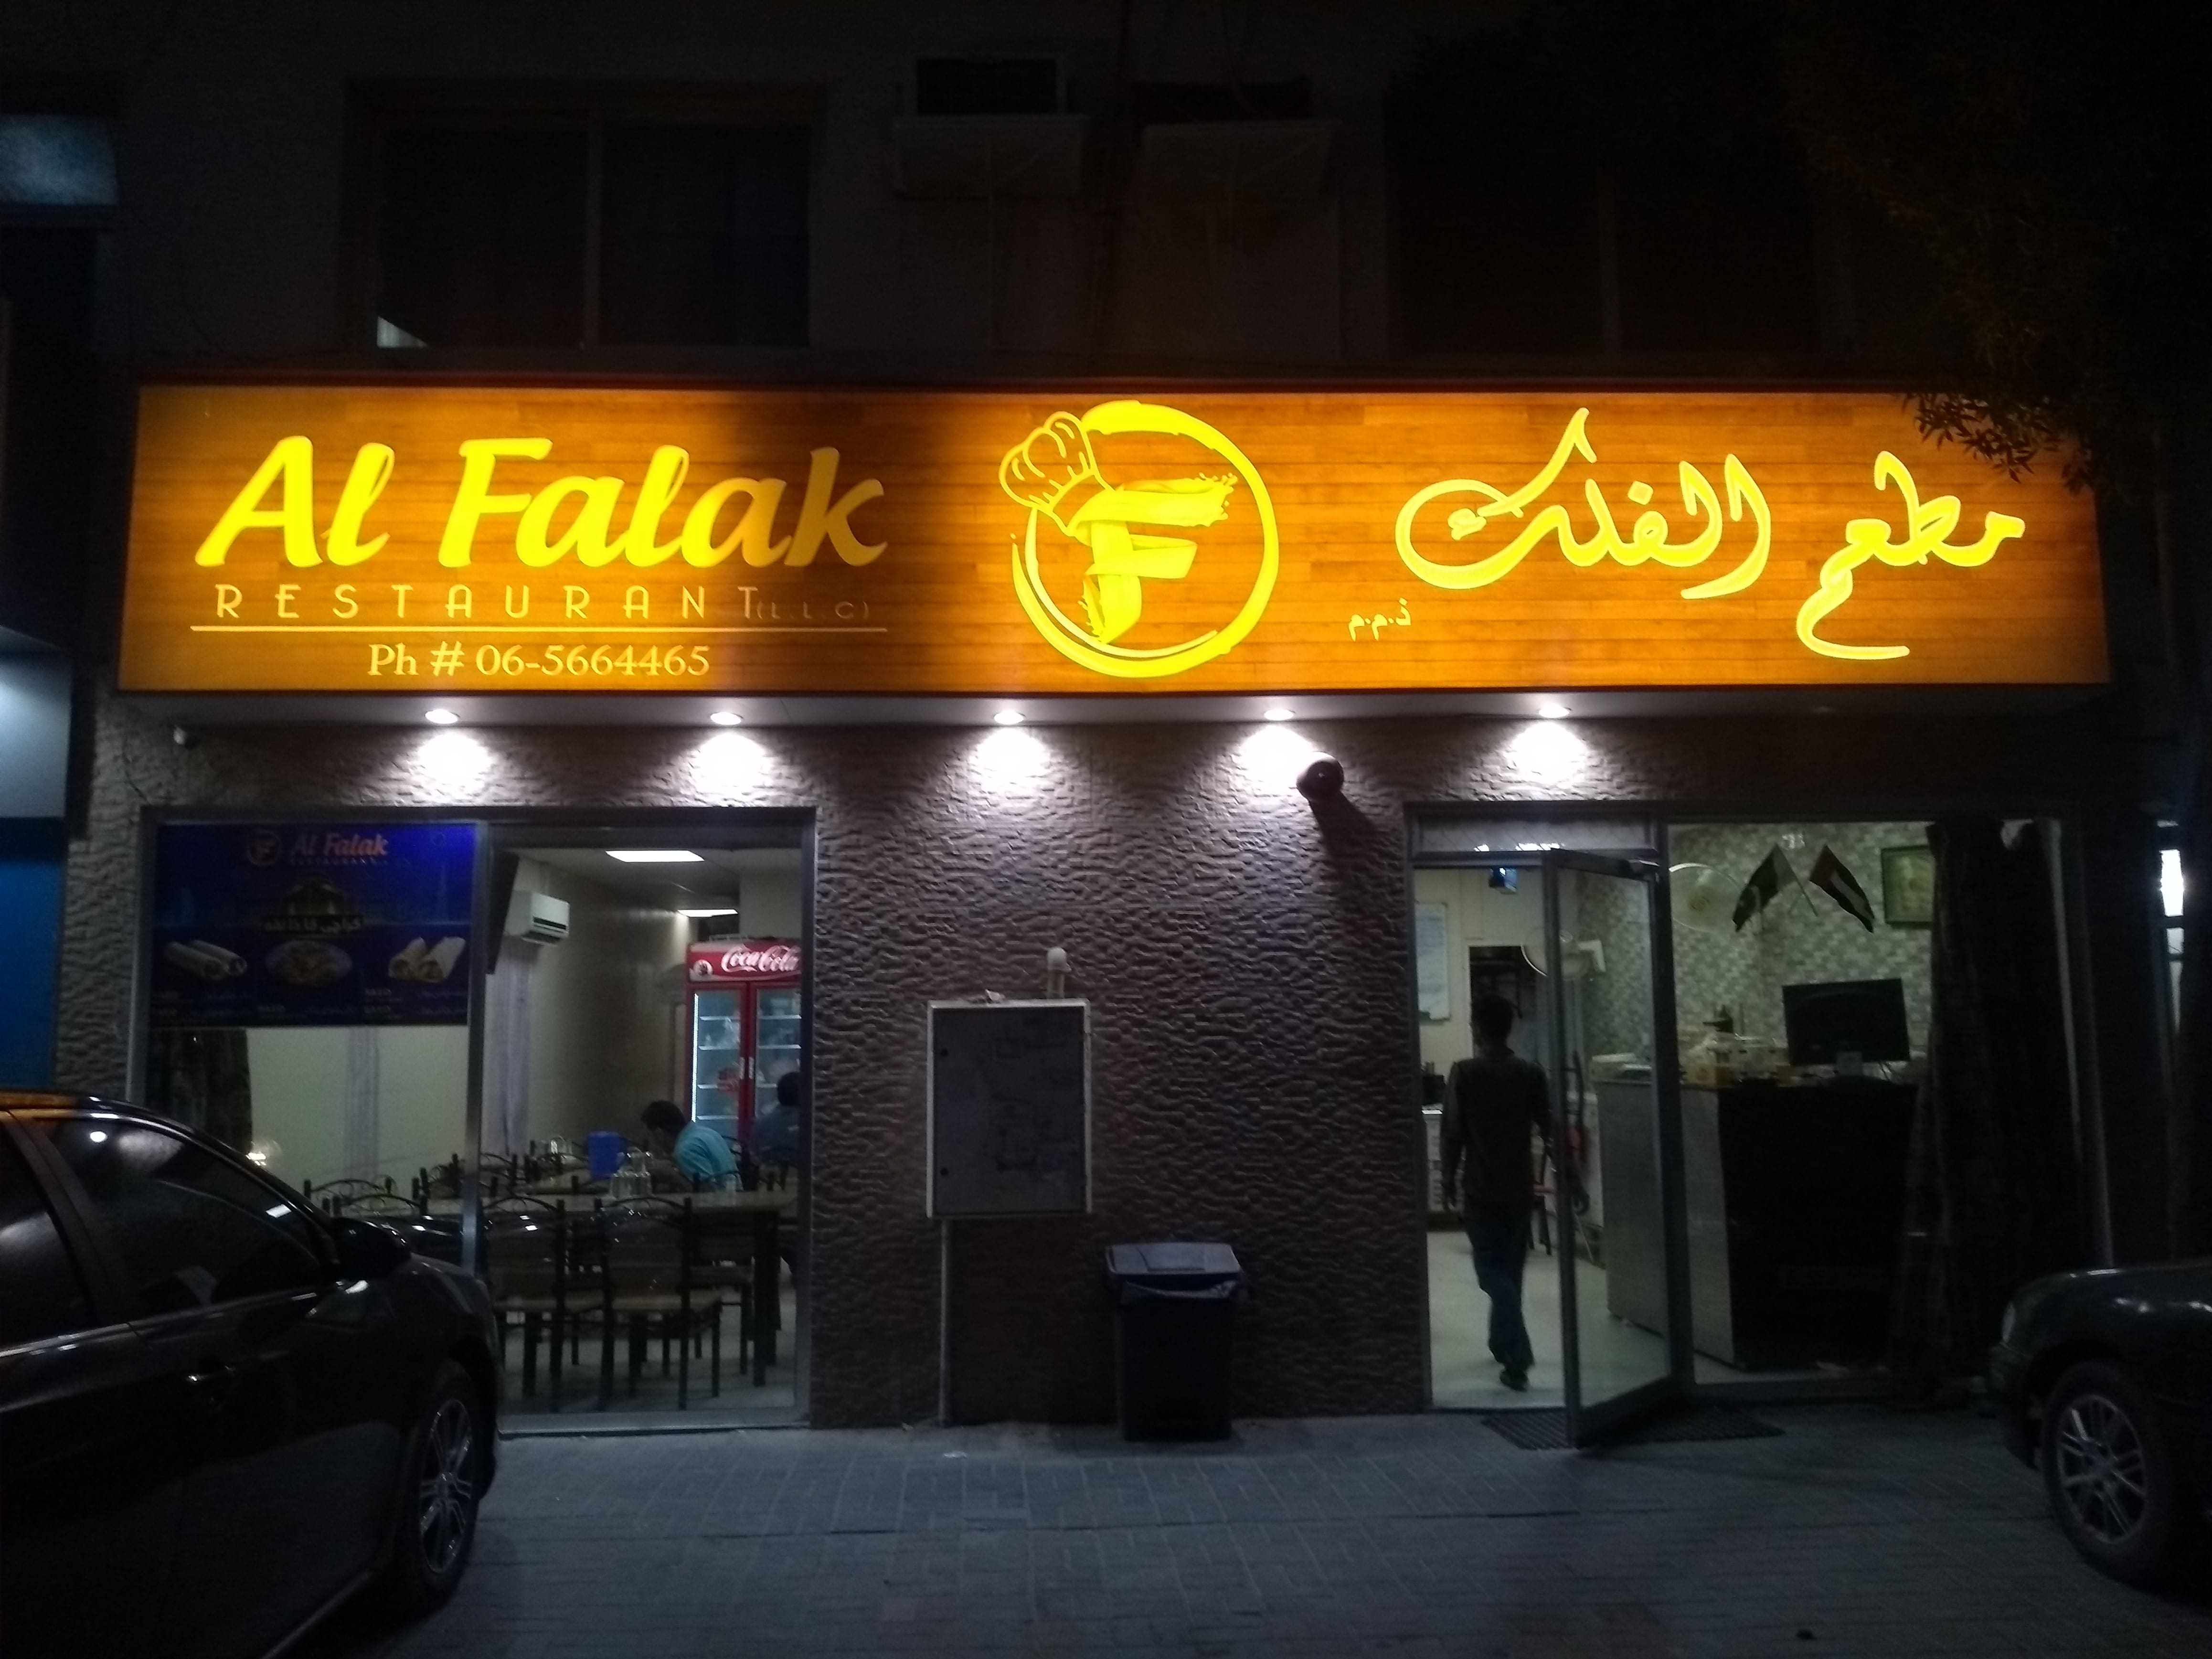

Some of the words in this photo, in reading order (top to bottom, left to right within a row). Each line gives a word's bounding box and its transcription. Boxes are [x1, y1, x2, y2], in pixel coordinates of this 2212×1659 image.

[194, 435, 395, 567] Al
[438, 436, 887, 567] Falak
[1395, 407, 1771, 599] الفلك
[1797, 451, 2025, 659] مطعم
[215, 584, 758, 619] RESTAURANT
[367, 642, 419, 676] Ph
[430, 640, 465, 676] #
[476, 644, 710, 676] 06-5664465
[290, 833, 318, 856] Al
[323, 832, 389, 856] Falak
